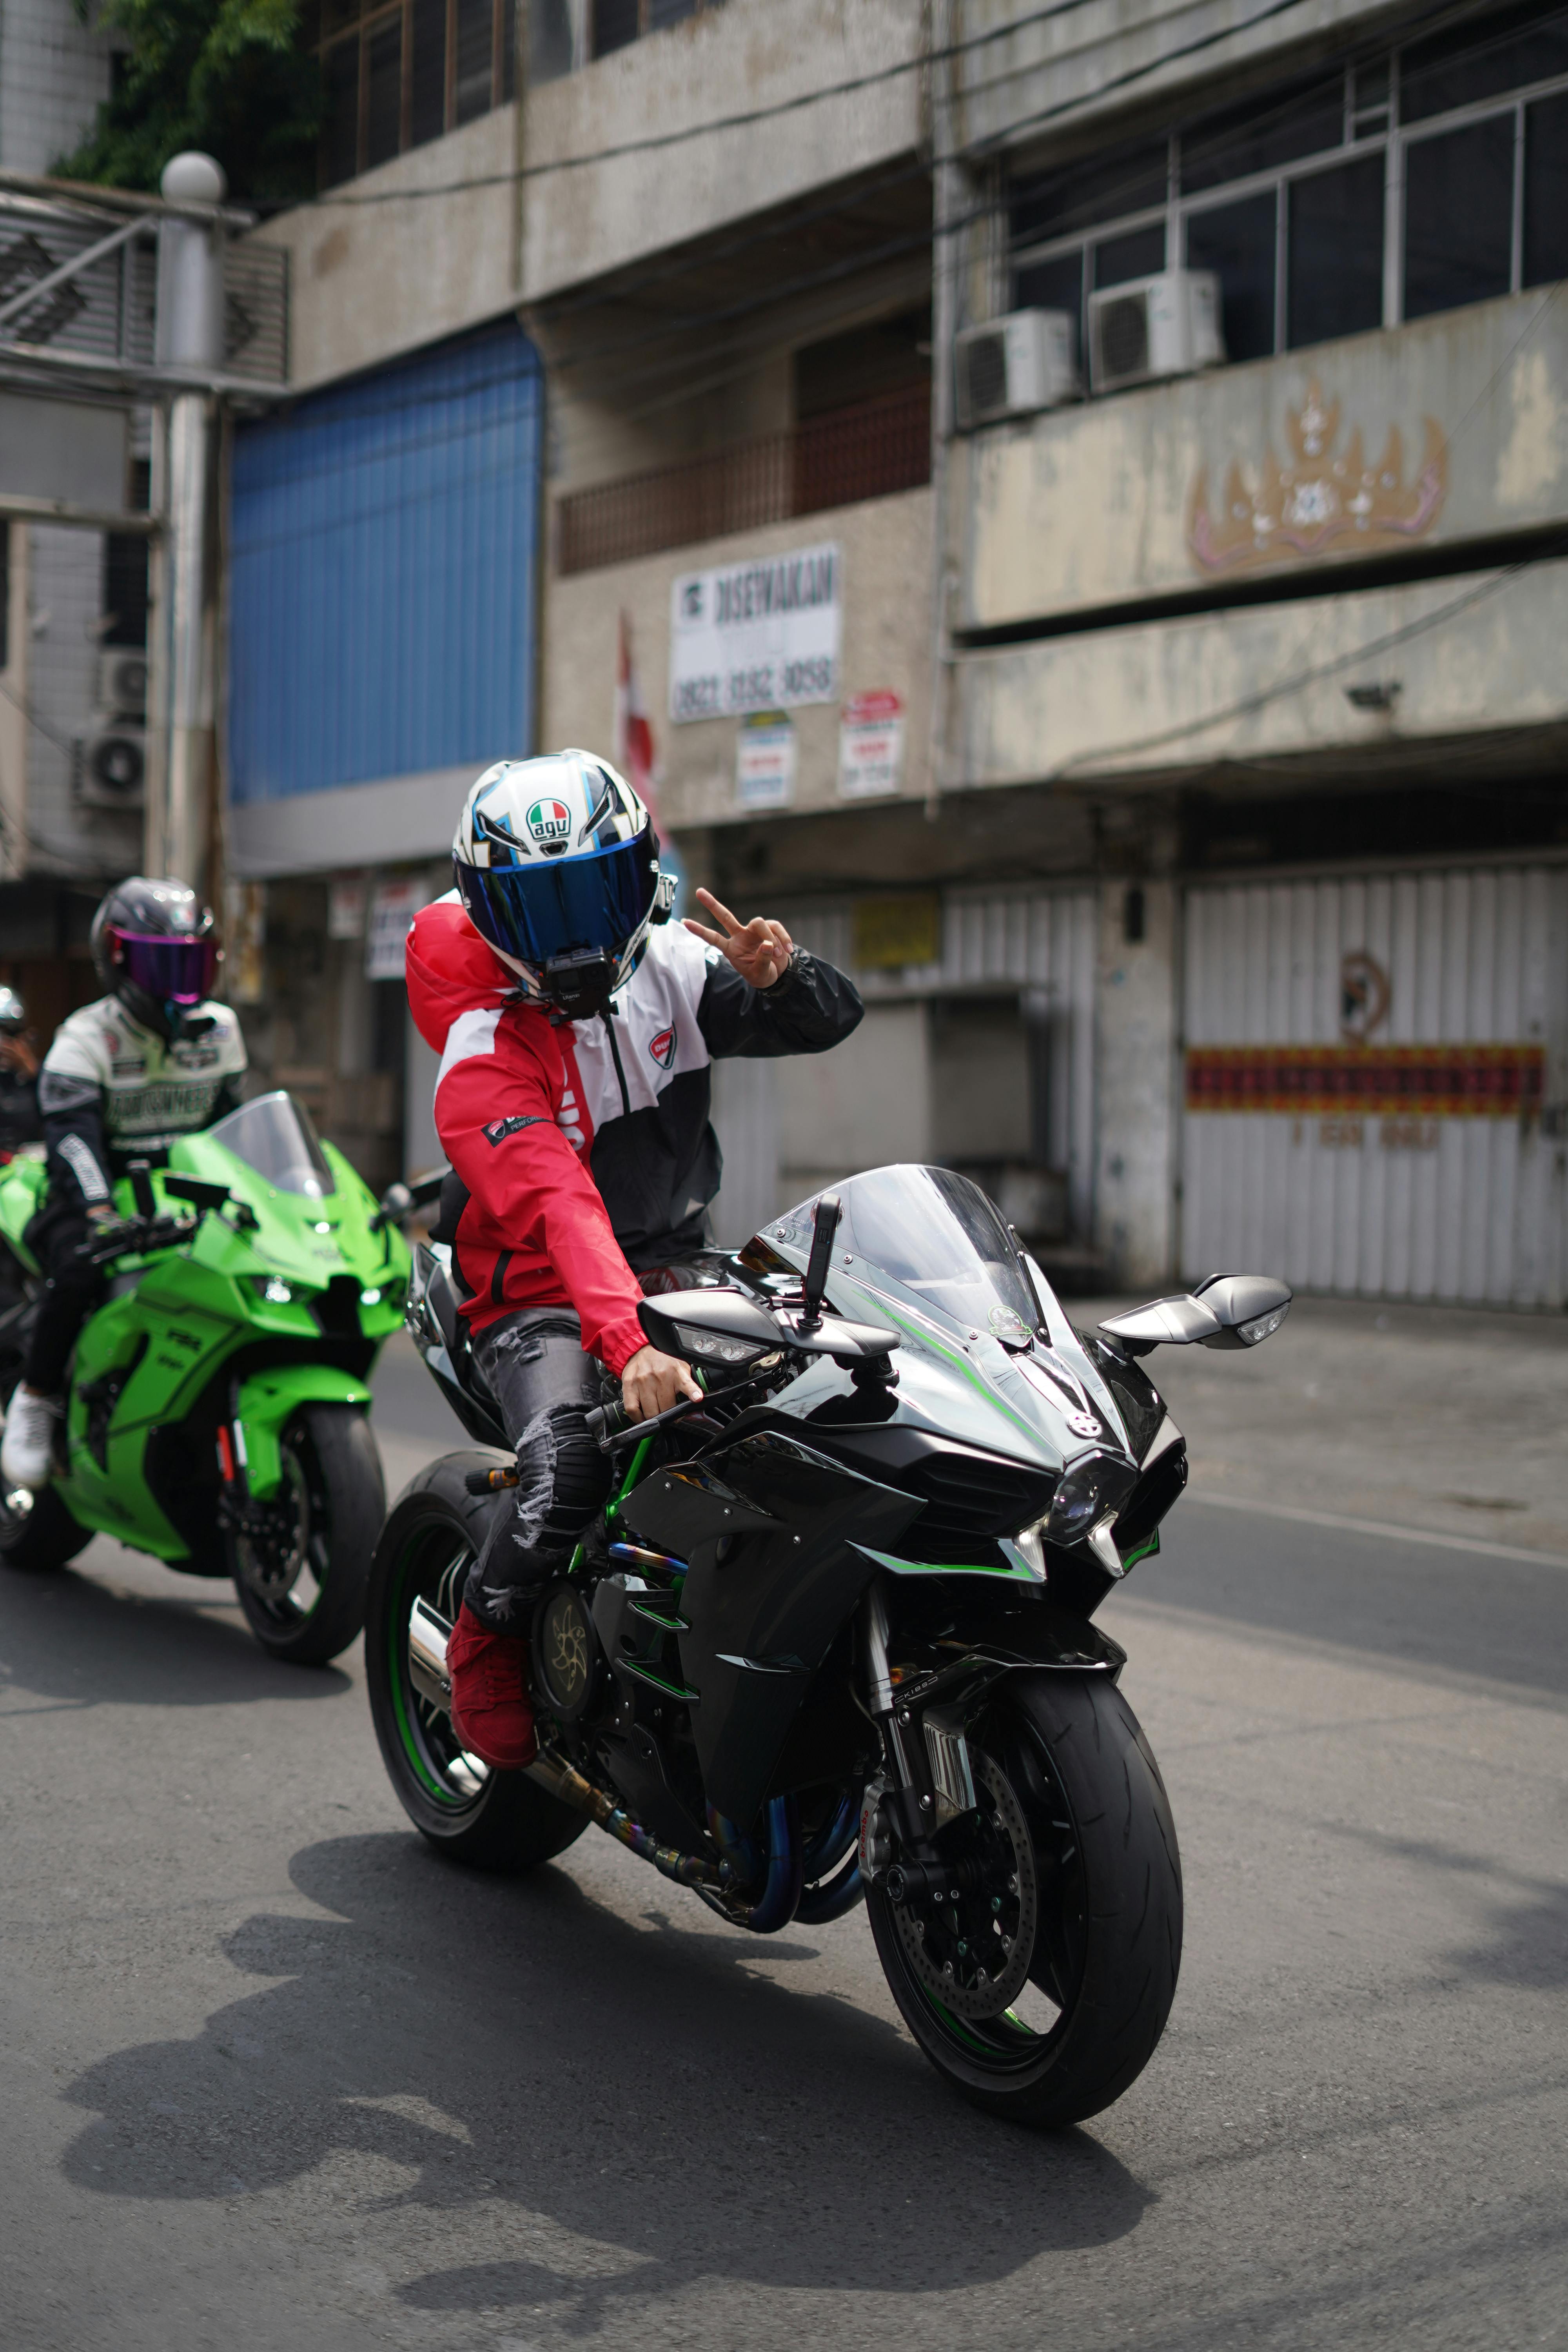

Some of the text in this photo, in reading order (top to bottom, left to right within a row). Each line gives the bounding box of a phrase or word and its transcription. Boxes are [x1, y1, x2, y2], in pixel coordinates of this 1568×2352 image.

[716, 552, 834, 623] DISEWAKAN
[904, 1682, 927, 1698] KIBS
[860, 1810, 869, 1858] brembo
